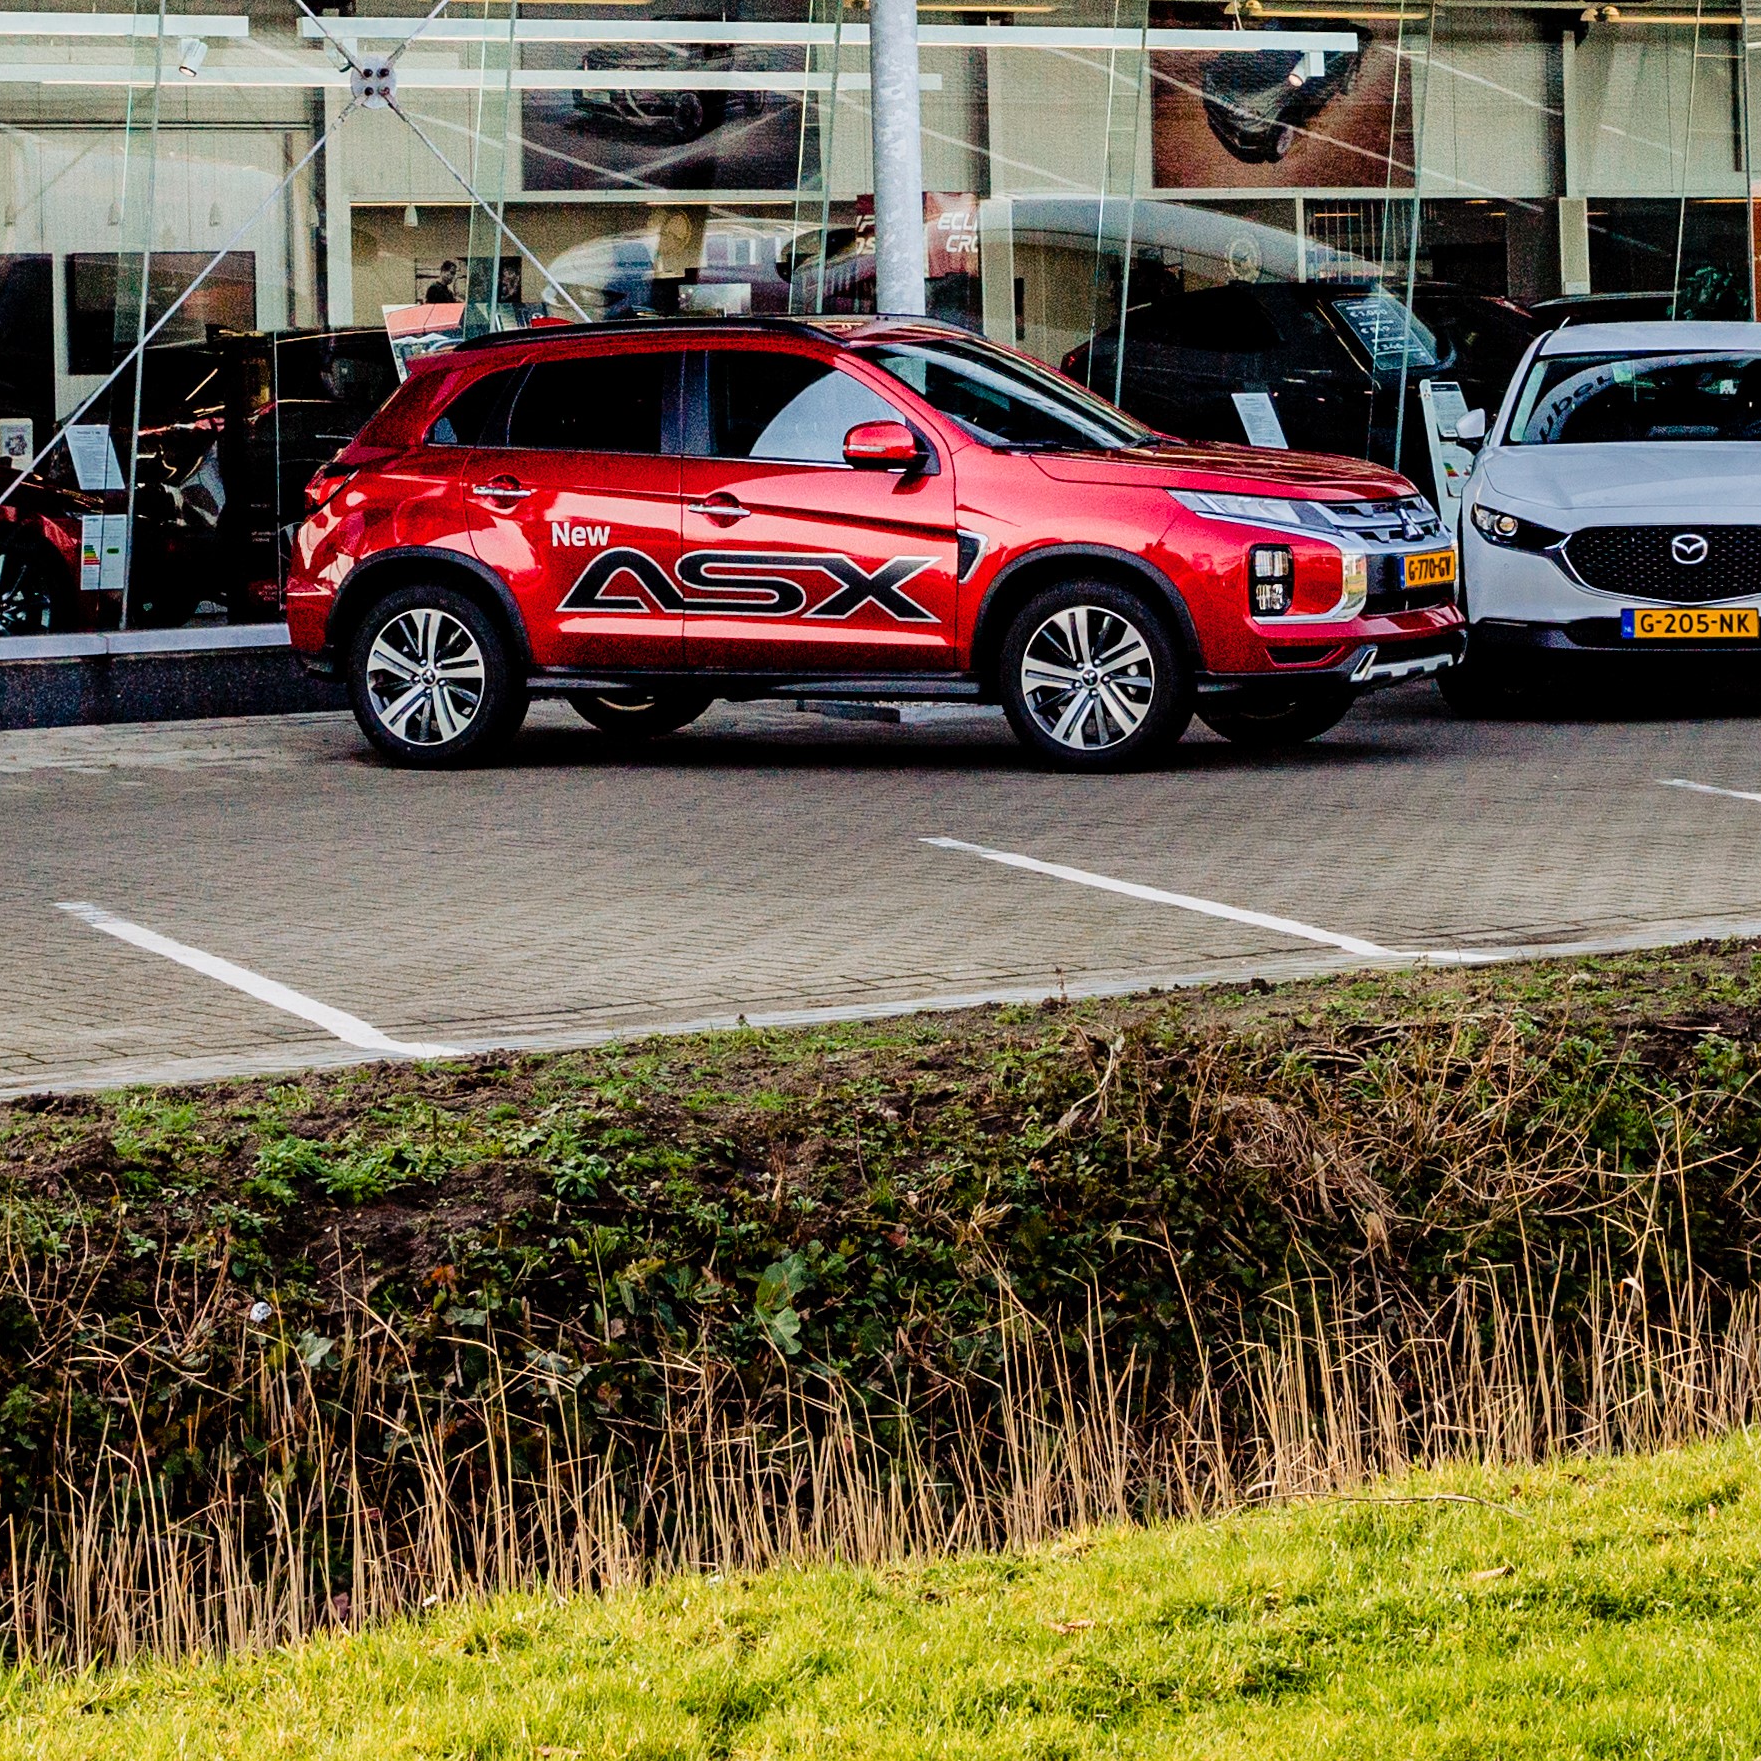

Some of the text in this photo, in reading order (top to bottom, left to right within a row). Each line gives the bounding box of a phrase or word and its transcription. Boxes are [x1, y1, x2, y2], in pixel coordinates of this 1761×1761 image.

[550, 521, 611, 548] New
[1407, 554, 1453, 581] G-770-GV
[555, 545, 943, 624] ASX
[1640, 612, 1751, 635] G-205-NK
